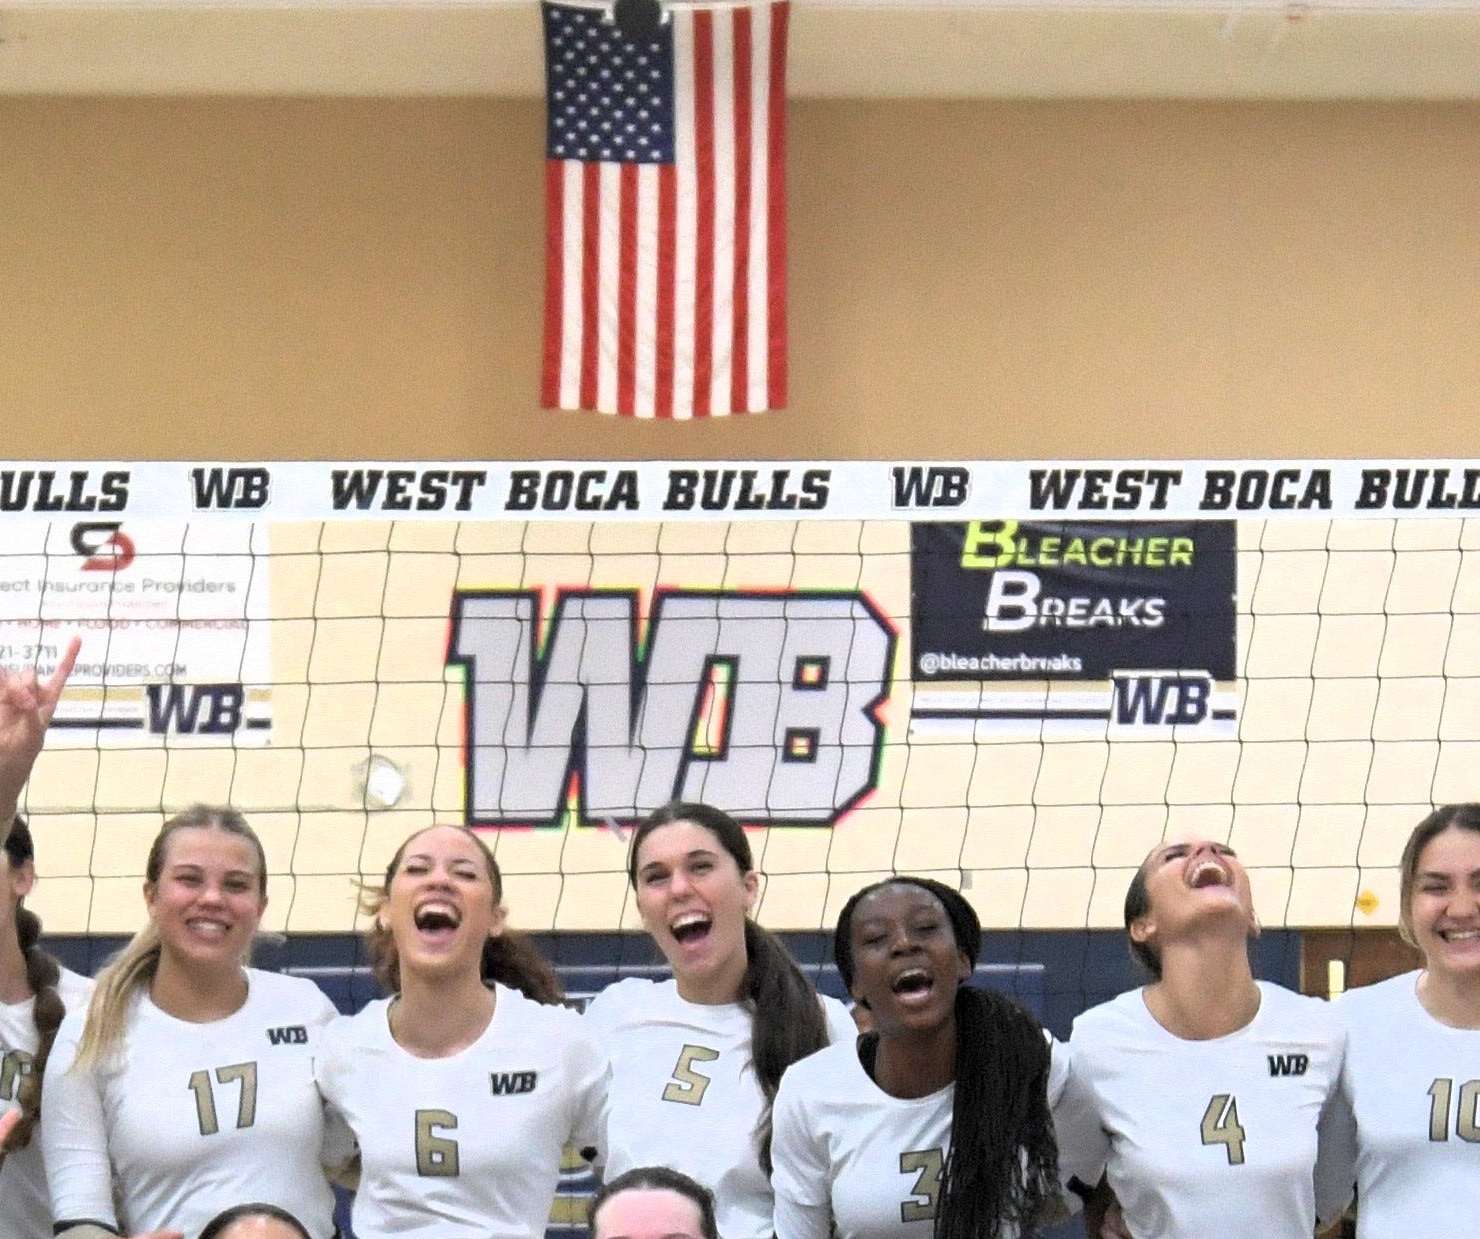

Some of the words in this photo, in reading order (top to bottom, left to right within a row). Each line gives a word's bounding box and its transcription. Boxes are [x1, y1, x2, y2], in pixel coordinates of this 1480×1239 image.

[191, 468, 271, 509] WB
[330, 470, 488, 511] WEST
[503, 470, 641, 511] BOCA
[661, 470, 832, 511] BULLS
[891, 466, 971, 507] WB
[1028, 469, 1183, 510] WEST
[1198, 469, 1333, 511] BOCA
[37, 577, 136, 594] Insurance
[142, 577, 237, 594] Providers
[145, 684, 246, 734] WB
[446, 587, 901, 830] WB
[1111, 674, 1213, 725] WB
[267, 1026, 309, 1046] WB
[490, 1071, 539, 1096] WB
[662, 1044, 720, 1106] 5
[1267, 1054, 1310, 1078] WB
[187, 1061, 258, 1135] 17
[414, 1109, 460, 1177] 6
[1199, 1094, 1247, 1166] 4
[899, 1147, 944, 1224] 3
